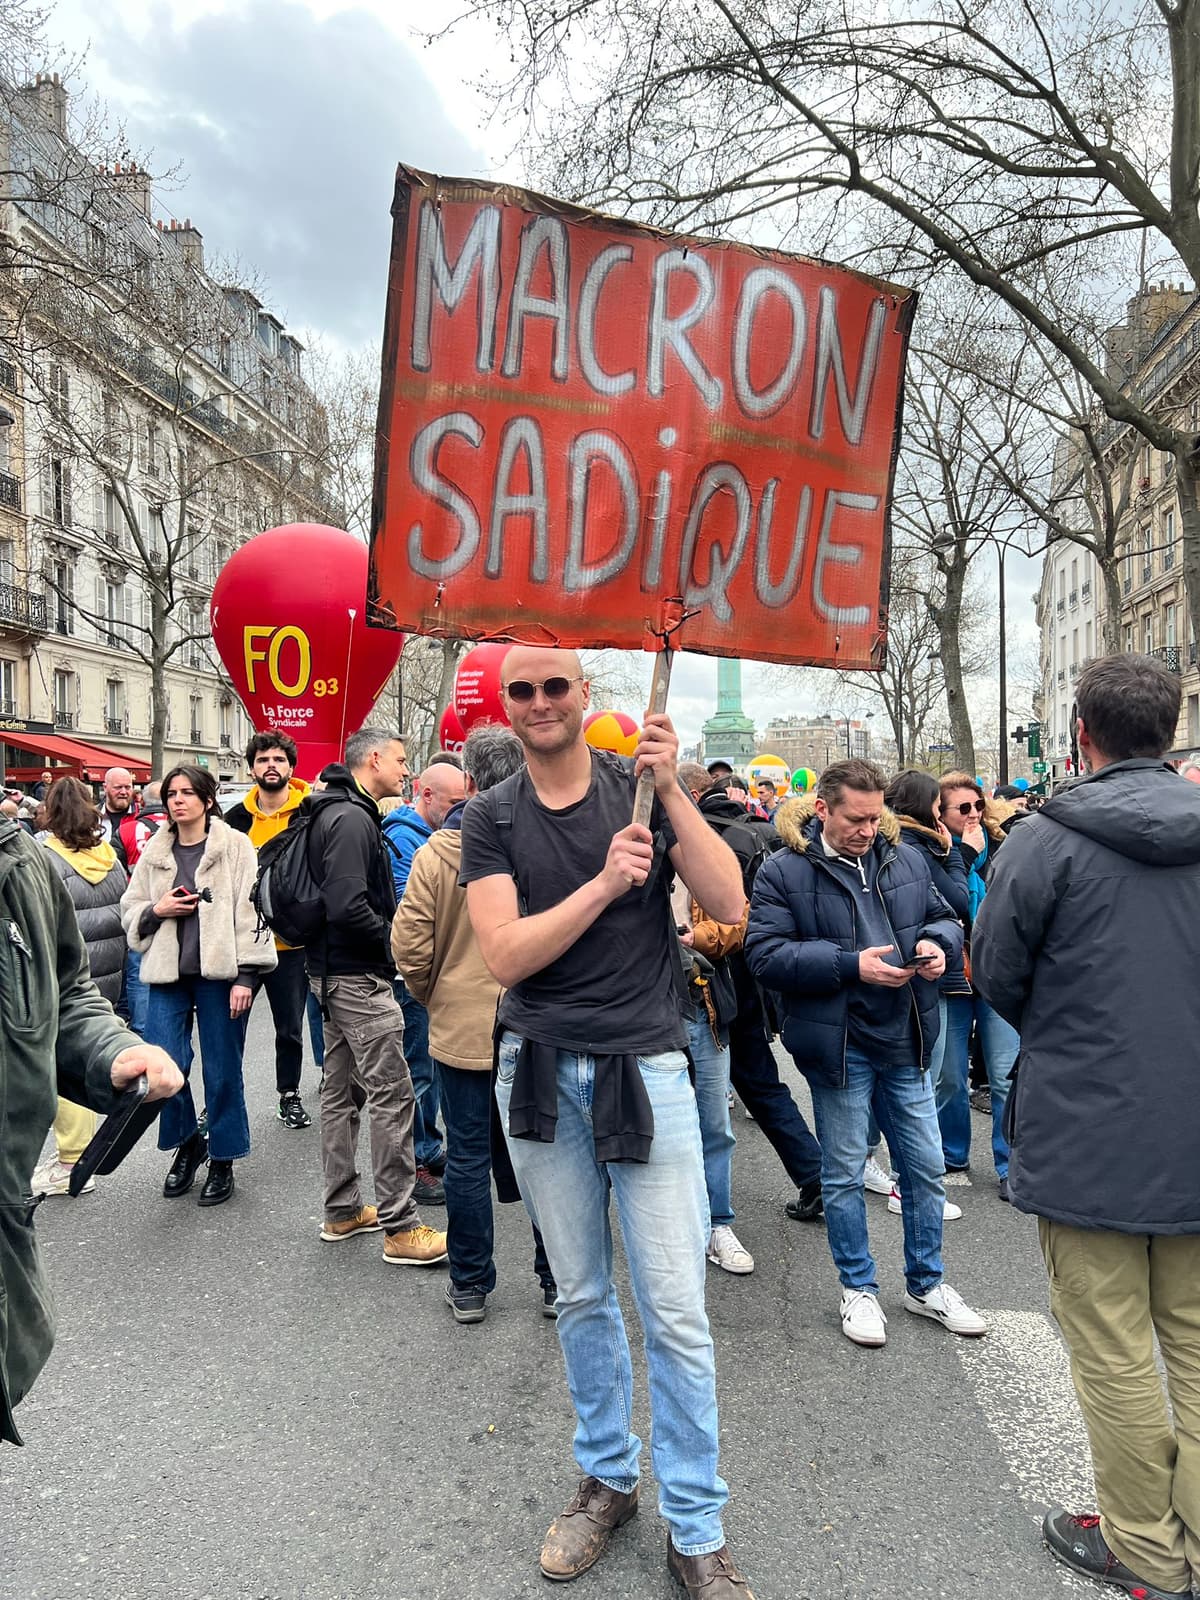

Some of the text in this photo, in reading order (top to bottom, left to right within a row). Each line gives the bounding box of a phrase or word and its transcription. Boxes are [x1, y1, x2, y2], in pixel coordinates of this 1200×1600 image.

[411, 202, 887, 446] MACRON
[407, 410, 883, 624] SADiQUE
[243, 625, 339, 698] FO 93
[261, 703, 314, 718] La Force
[268, 717, 307, 728] Syndicale
